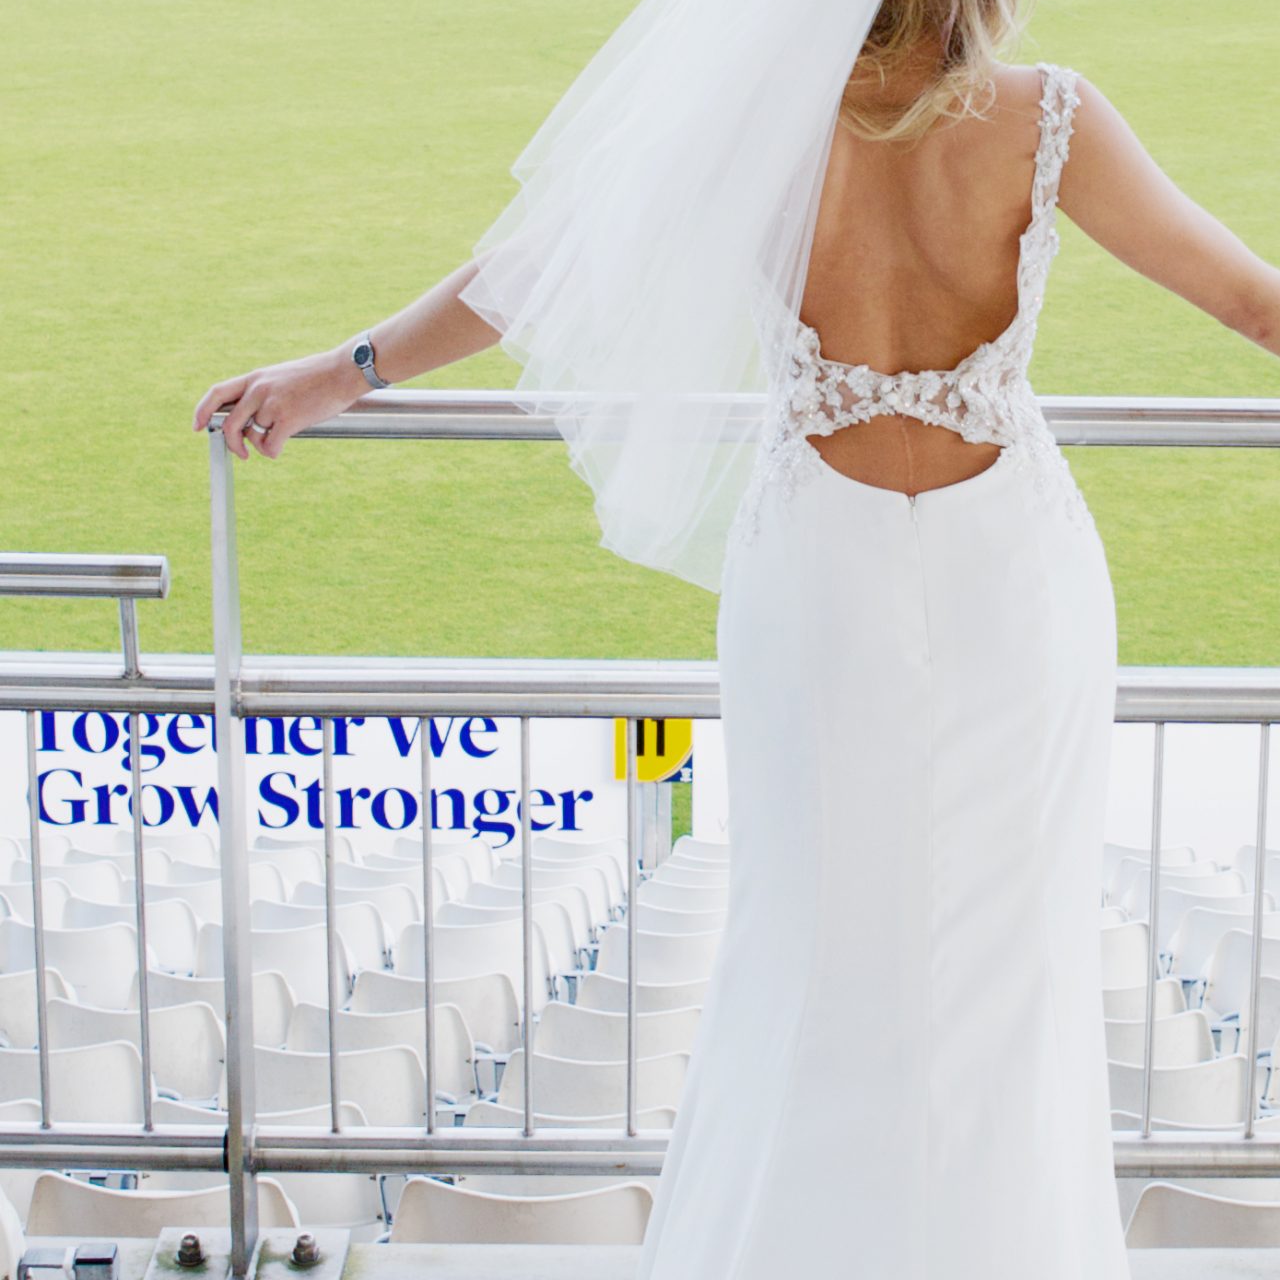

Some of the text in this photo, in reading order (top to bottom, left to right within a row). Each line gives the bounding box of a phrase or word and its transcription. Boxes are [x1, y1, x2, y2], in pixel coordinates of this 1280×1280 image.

[36, 712, 499, 772] Togeher We
[27, 768, 593, 848] Grow Stronger
